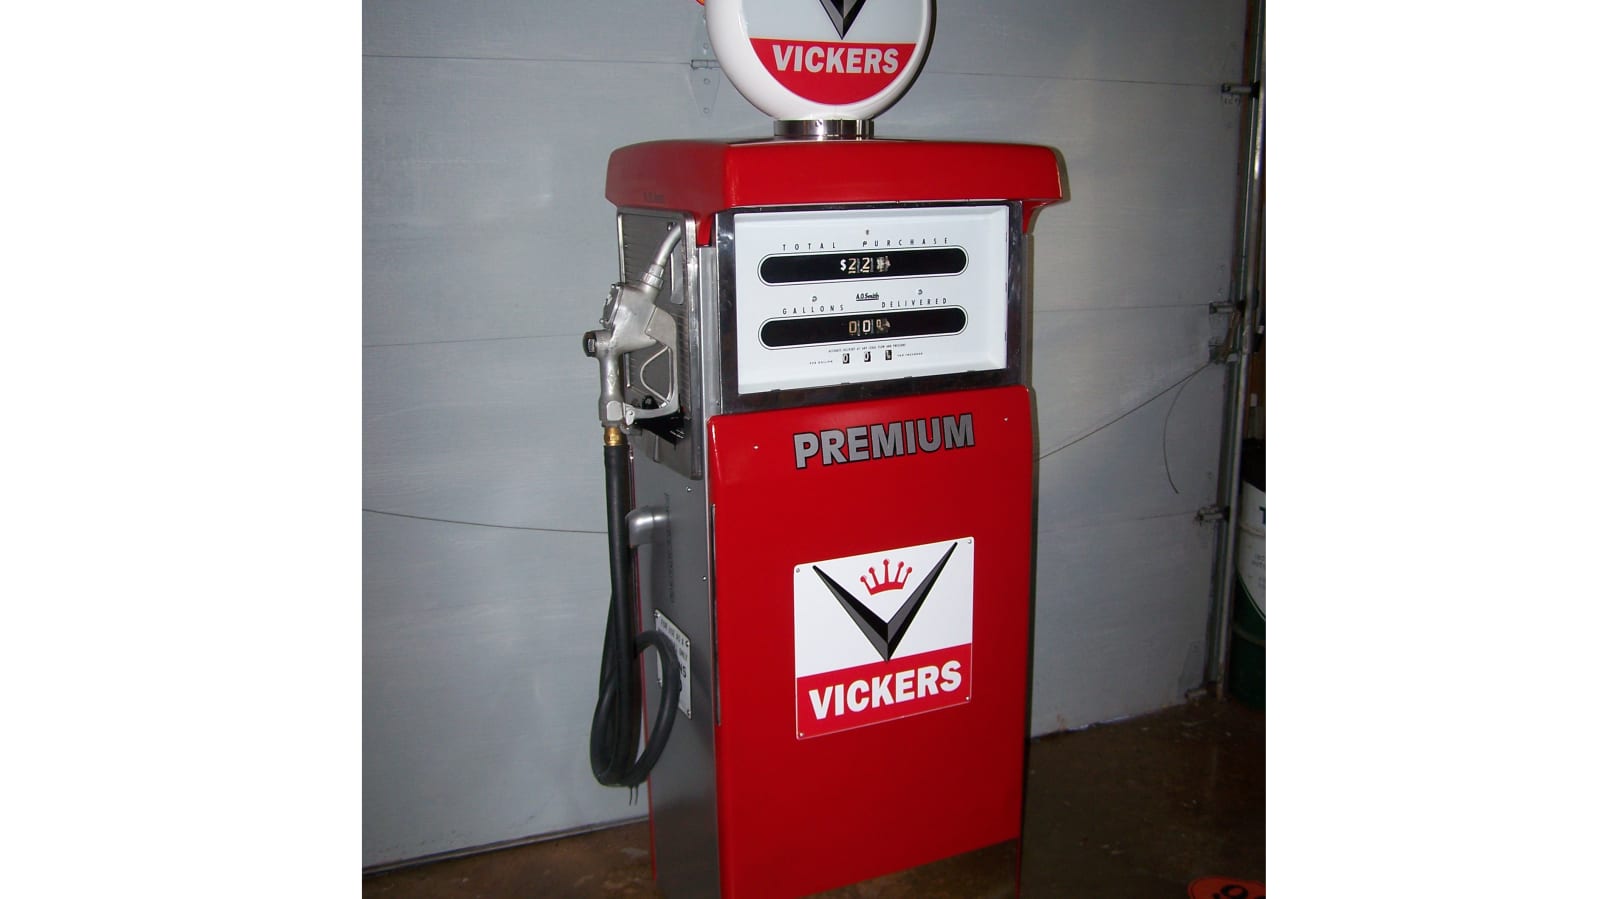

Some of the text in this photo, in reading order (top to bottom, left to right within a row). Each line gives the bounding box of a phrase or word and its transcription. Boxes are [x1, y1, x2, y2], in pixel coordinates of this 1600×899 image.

[772, 44, 899, 74] VICKERS
[782, 237, 948, 251] TOTAL PURCHASE
[782, 297, 947, 315] GALLONS DELIVERED
[793, 412, 976, 469] PREMIUM
[809, 659, 962, 720] VICKERS
